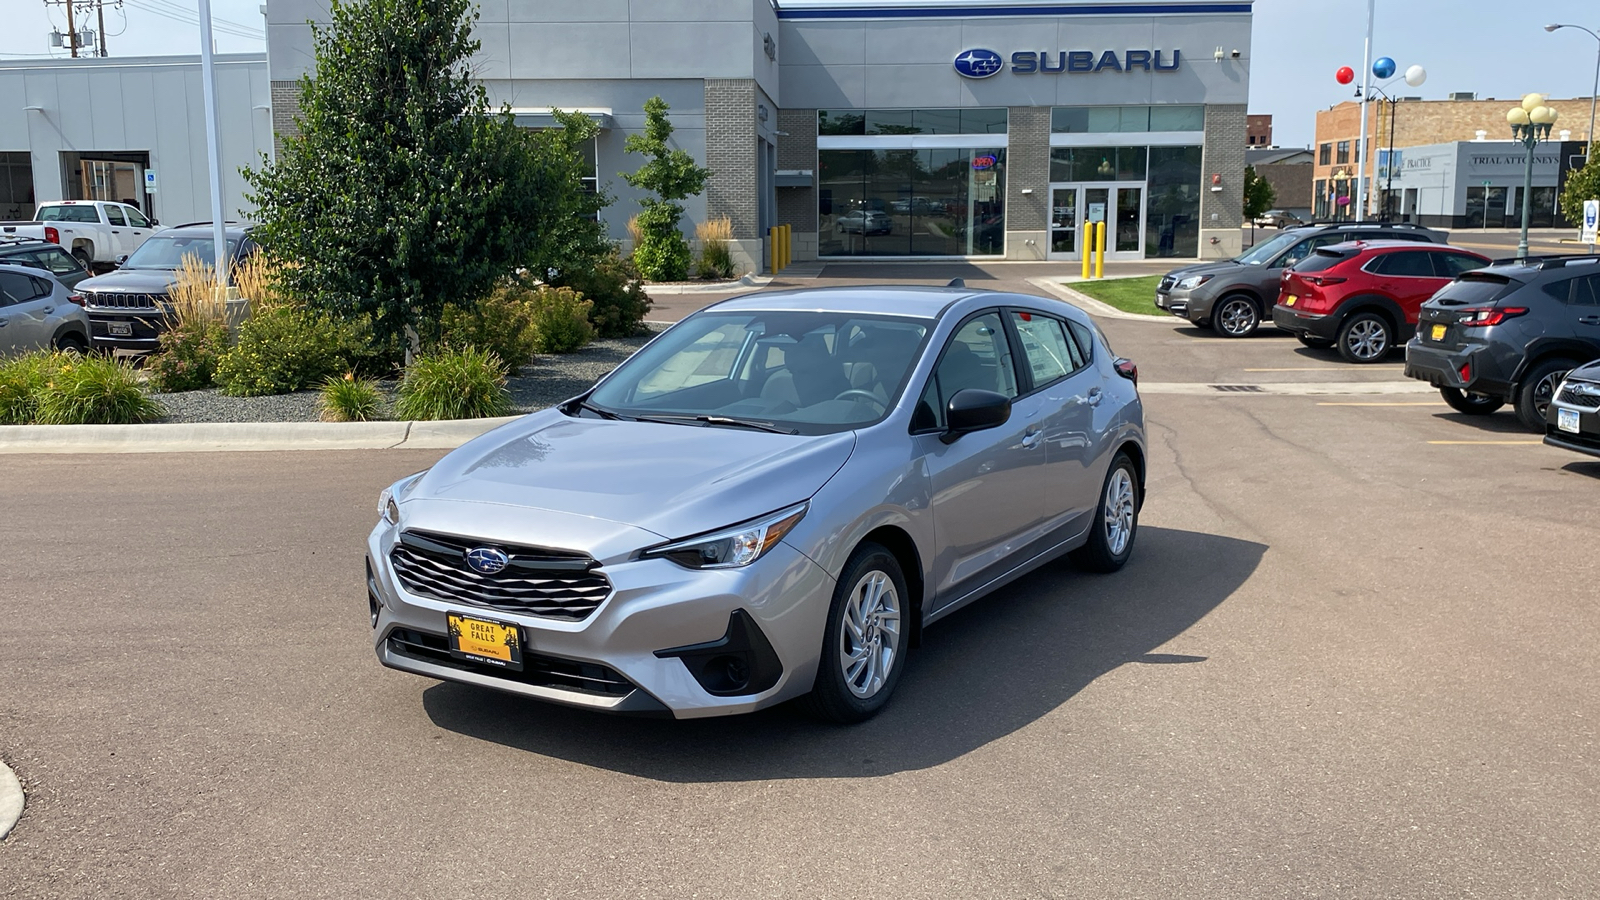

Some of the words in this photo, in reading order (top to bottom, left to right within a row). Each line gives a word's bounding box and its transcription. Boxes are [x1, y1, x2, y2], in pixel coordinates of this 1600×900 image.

[1011, 49, 1181, 73] SUBARU
[972, 157, 993, 168] OPEN
[1407, 158, 1431, 168] PRACTICE
[1472, 156, 1502, 164] TRIAL
[470, 622, 494, 633] GREAT
[472, 631, 495, 642] FALLS
